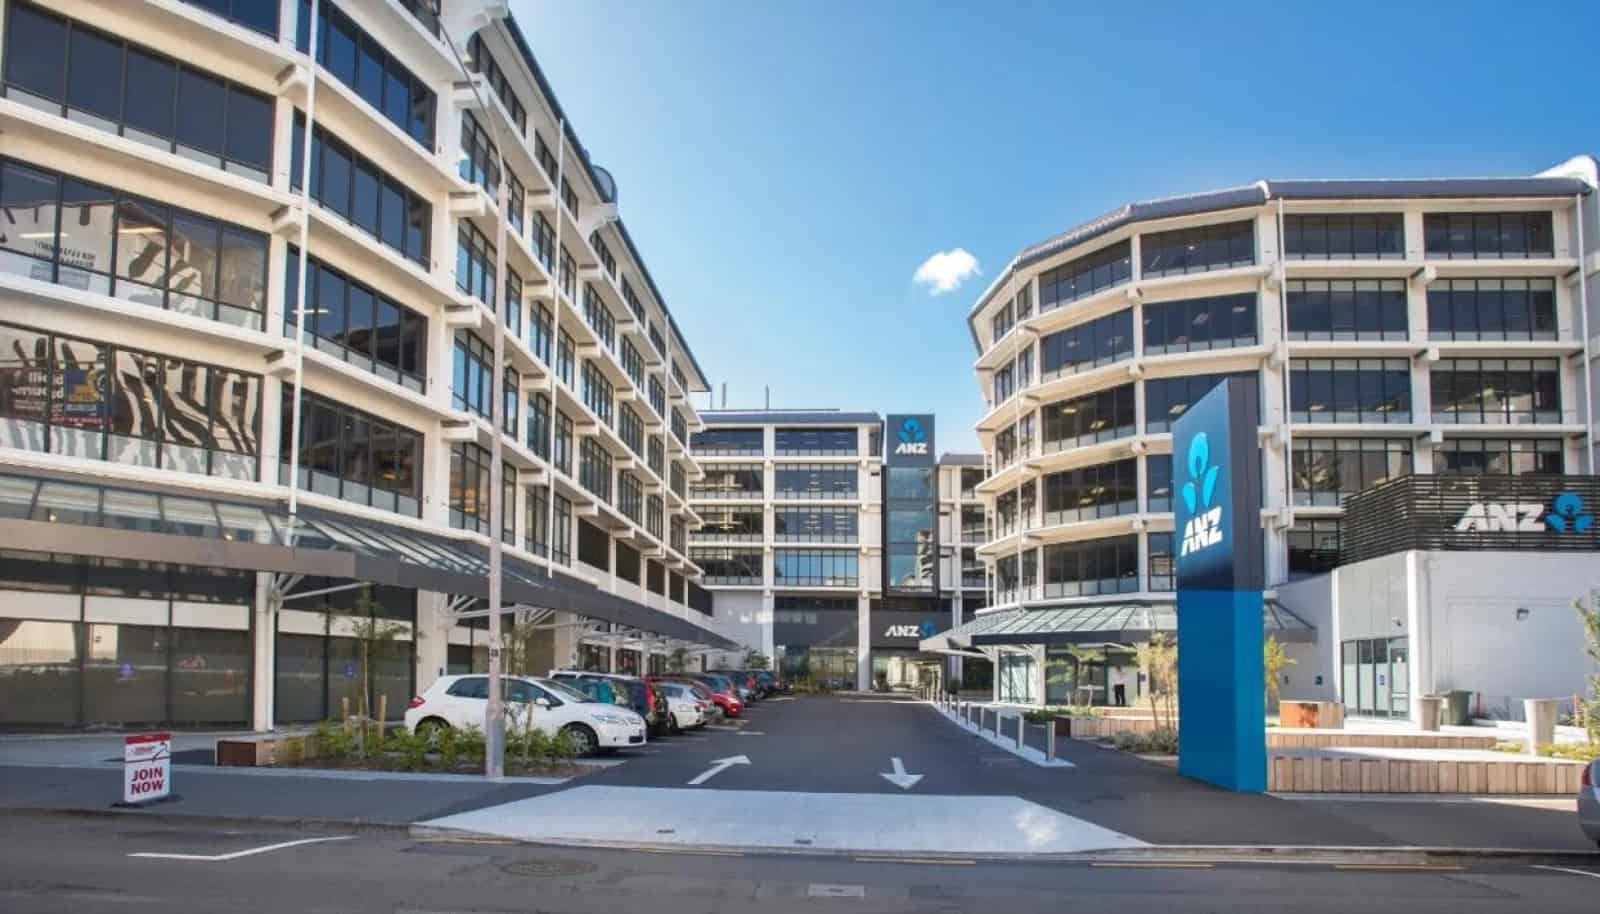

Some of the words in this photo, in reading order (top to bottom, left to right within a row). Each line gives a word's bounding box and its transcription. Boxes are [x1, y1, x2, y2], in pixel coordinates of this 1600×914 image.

[895, 442, 928, 454] ANZ
[1455, 503, 1546, 532] ANZ
[1180, 506, 1223, 557] ANZ
[884, 625, 920, 637] ANZ
[131, 767, 163, 781] JOIN
[131, 780, 164, 795] NOW
